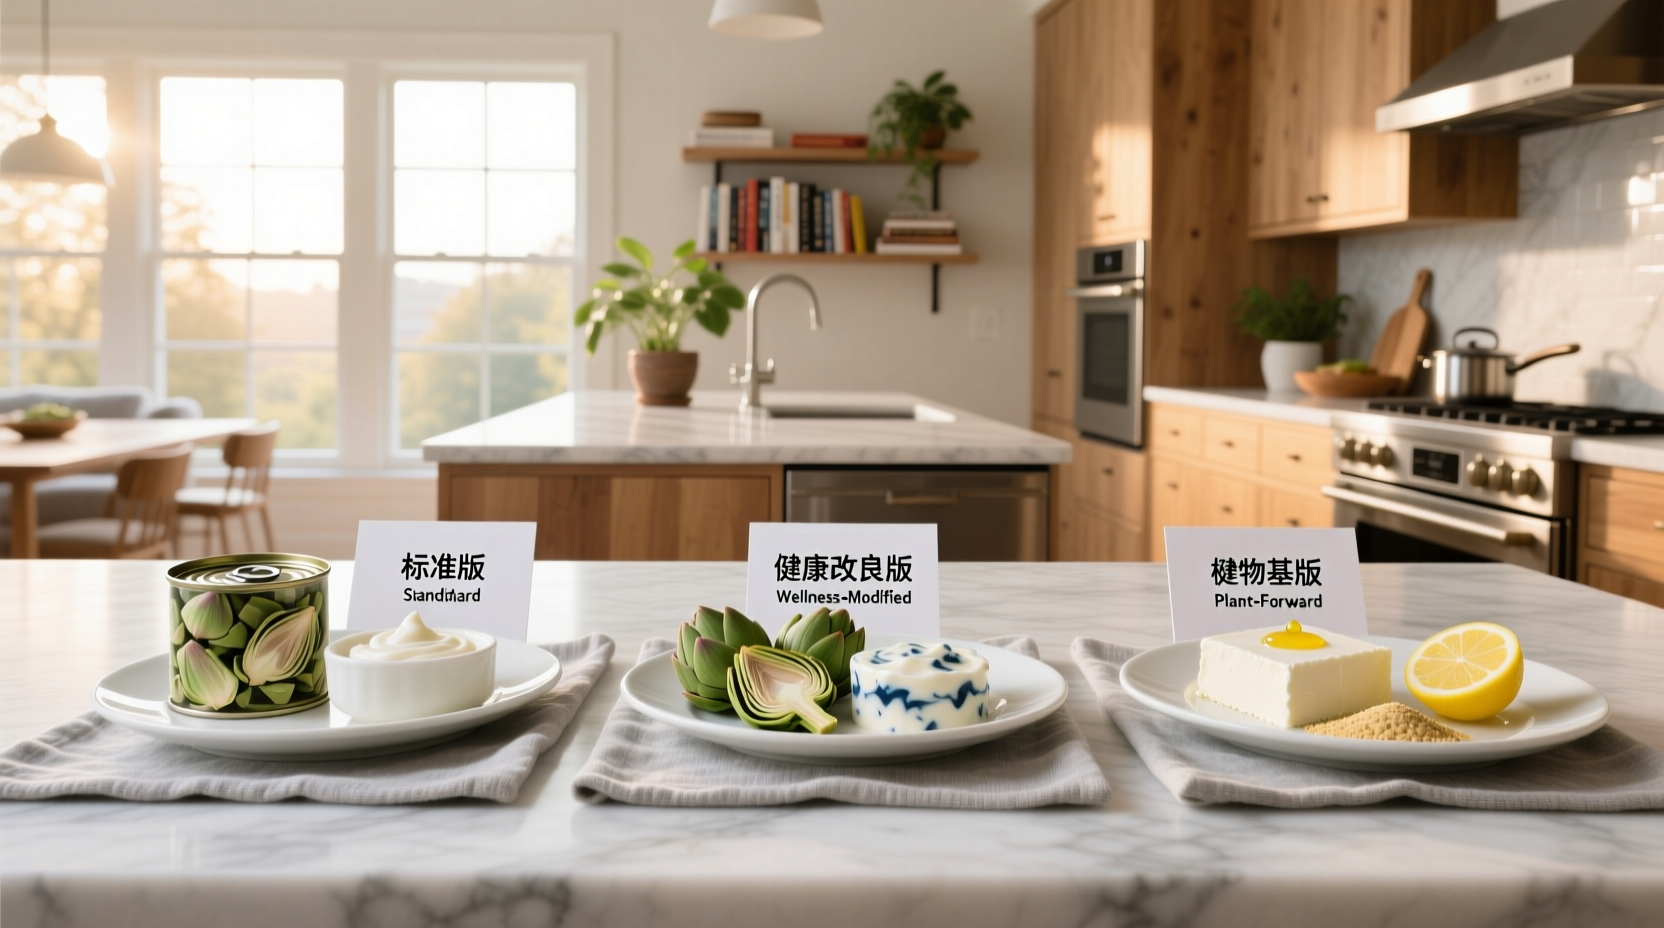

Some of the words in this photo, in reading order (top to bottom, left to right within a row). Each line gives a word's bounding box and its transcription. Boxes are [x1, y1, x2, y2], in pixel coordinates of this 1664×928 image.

[400, 551, 487, 582] 标准版
[774, 553, 913, 583] 健康改良版
[1214, 592, 1323, 609] Plant-Forward
